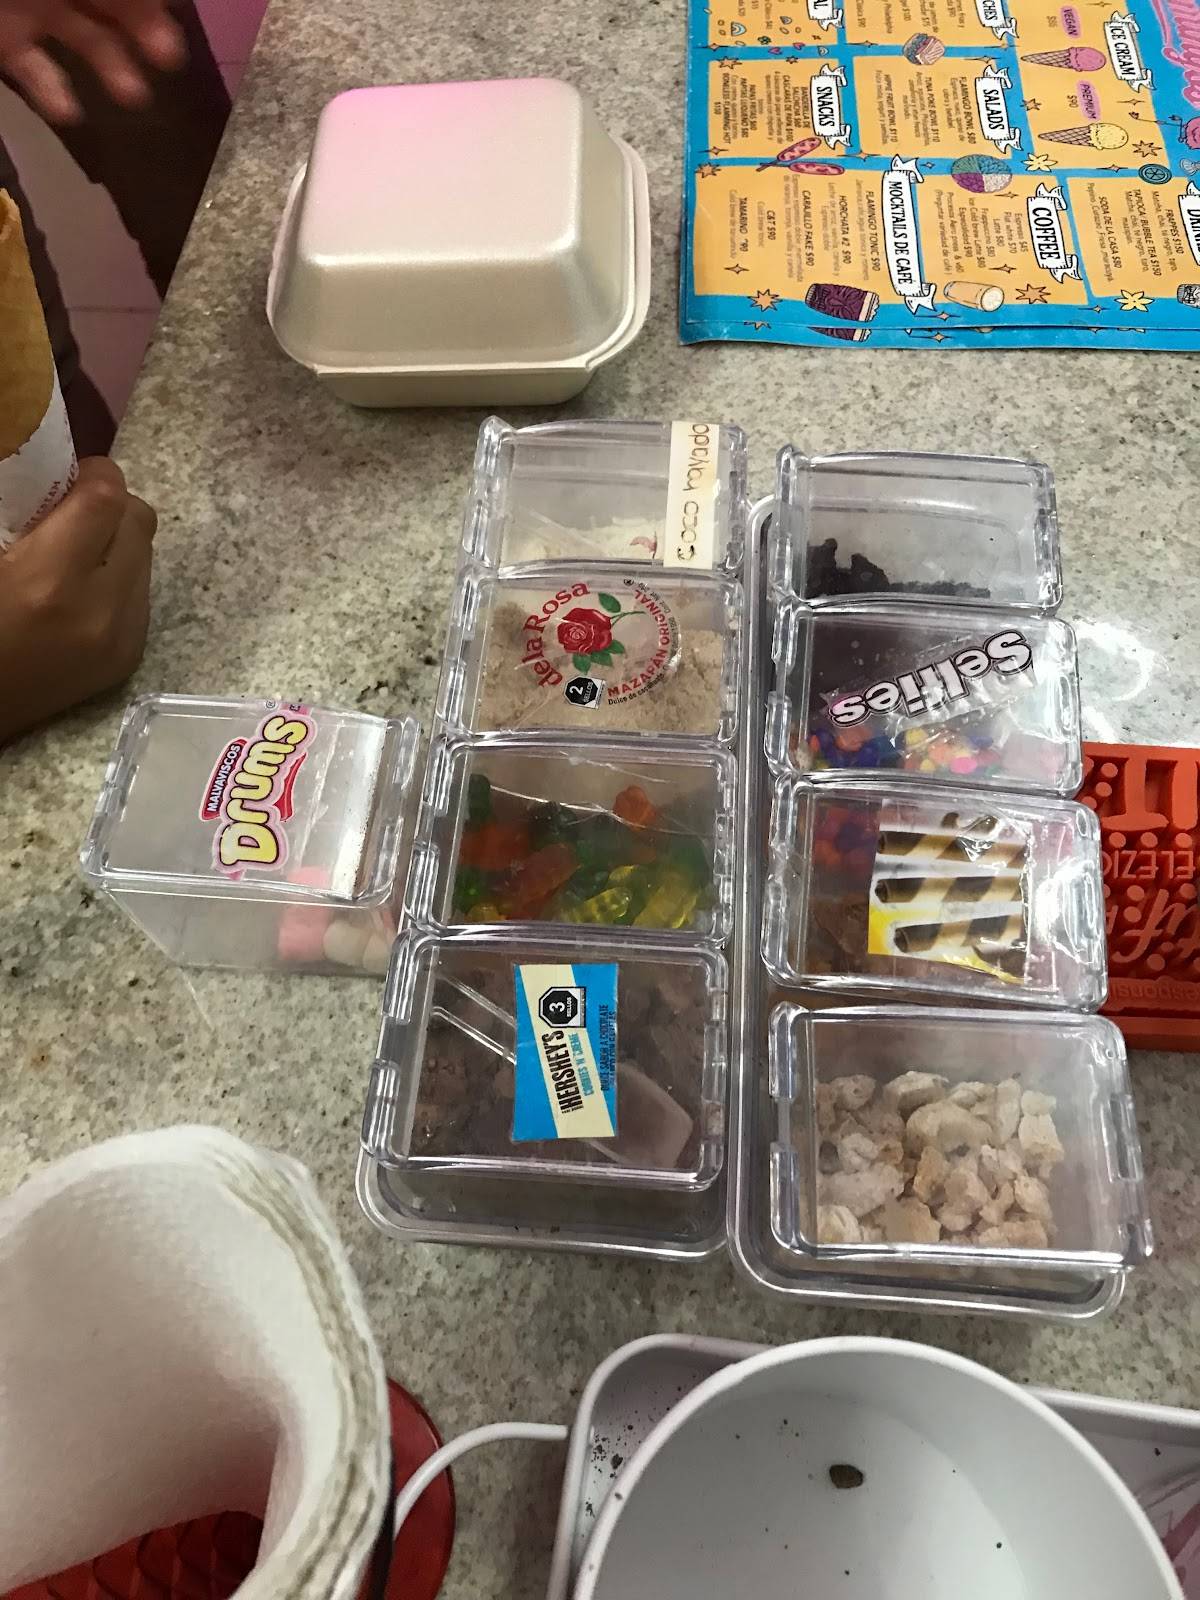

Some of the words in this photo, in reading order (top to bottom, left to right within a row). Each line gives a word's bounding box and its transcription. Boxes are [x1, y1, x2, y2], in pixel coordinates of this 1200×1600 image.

[1064, 9, 1077, 36] VEGAN
[1110, 26, 1125, 39] ICE
[1115, 42, 1135, 75] CREAM
[960, 77, 972, 110] FLAMINGO
[1067, 95, 1078, 108] $90
[1080, 84, 1096, 119] PREMIUM
[817, 87, 834, 126] SNACKS
[983, 89, 1004, 130] SALADS
[888, 110, 896, 126] BOWL
[929, 110, 938, 126] BOWL
[964, 112, 974, 130] BOWL
[802, 190, 812, 229] CARAJILLO
[840, 195, 849, 234] HORCHATA
[866, 192, 876, 230] FLAMINGO
[889, 181, 907, 238] MOCKTAILS
[970, 207, 979, 221] Cold
[1099, 196, 1110, 214] SODA
[972, 223, 980, 238] brew
[993, 219, 1002, 234] Latte
[1103, 216, 1112, 225] DE
[1106, 226, 1114, 234] LA
[768, 227, 776, 240] $90
[805, 231, 813, 249] FAKE
[1032, 208, 1060, 260] COFFEE
[1141, 220, 1153, 243] BUBBLE
[1166, 209, 1178, 236] FRAPPES
[1173, 239, 1184, 254] $150
[870, 232, 879, 254] TONIC
[894, 242, 909, 254] DE
[943, 249, 949, 257] de
[1008, 243, 1016, 254] $70
[1019, 242, 1028, 252] $45
[1108, 236, 1119, 254] CASA
[1148, 246, 1156, 258] TEA
[806, 252, 814, 266] $90
[842, 250, 851, 264] $90
[872, 258, 880, 271] $90
[896, 258, 916, 284] CAFÉ
[1151, 260, 1161, 276] $150
[523, 583, 591, 634] Rosa
[634, 589, 670, 646] ORIGINAL
[607, 650, 668, 697] MAZAPÁN
[829, 629, 1034, 728] Selfies
[569, 685, 584, 695] 2
[206, 744, 241, 812] MALVAVISCOS
[219, 716, 308, 866] Drums
[549, 1002, 566, 1012] 3
[599, 1004, 609, 1040] CHOCOLATE
[600, 1047, 609, 1070] SABOR
[541, 1030, 583, 1110] HERSHEY'S
[579, 1065, 594, 1097] COOKIES
